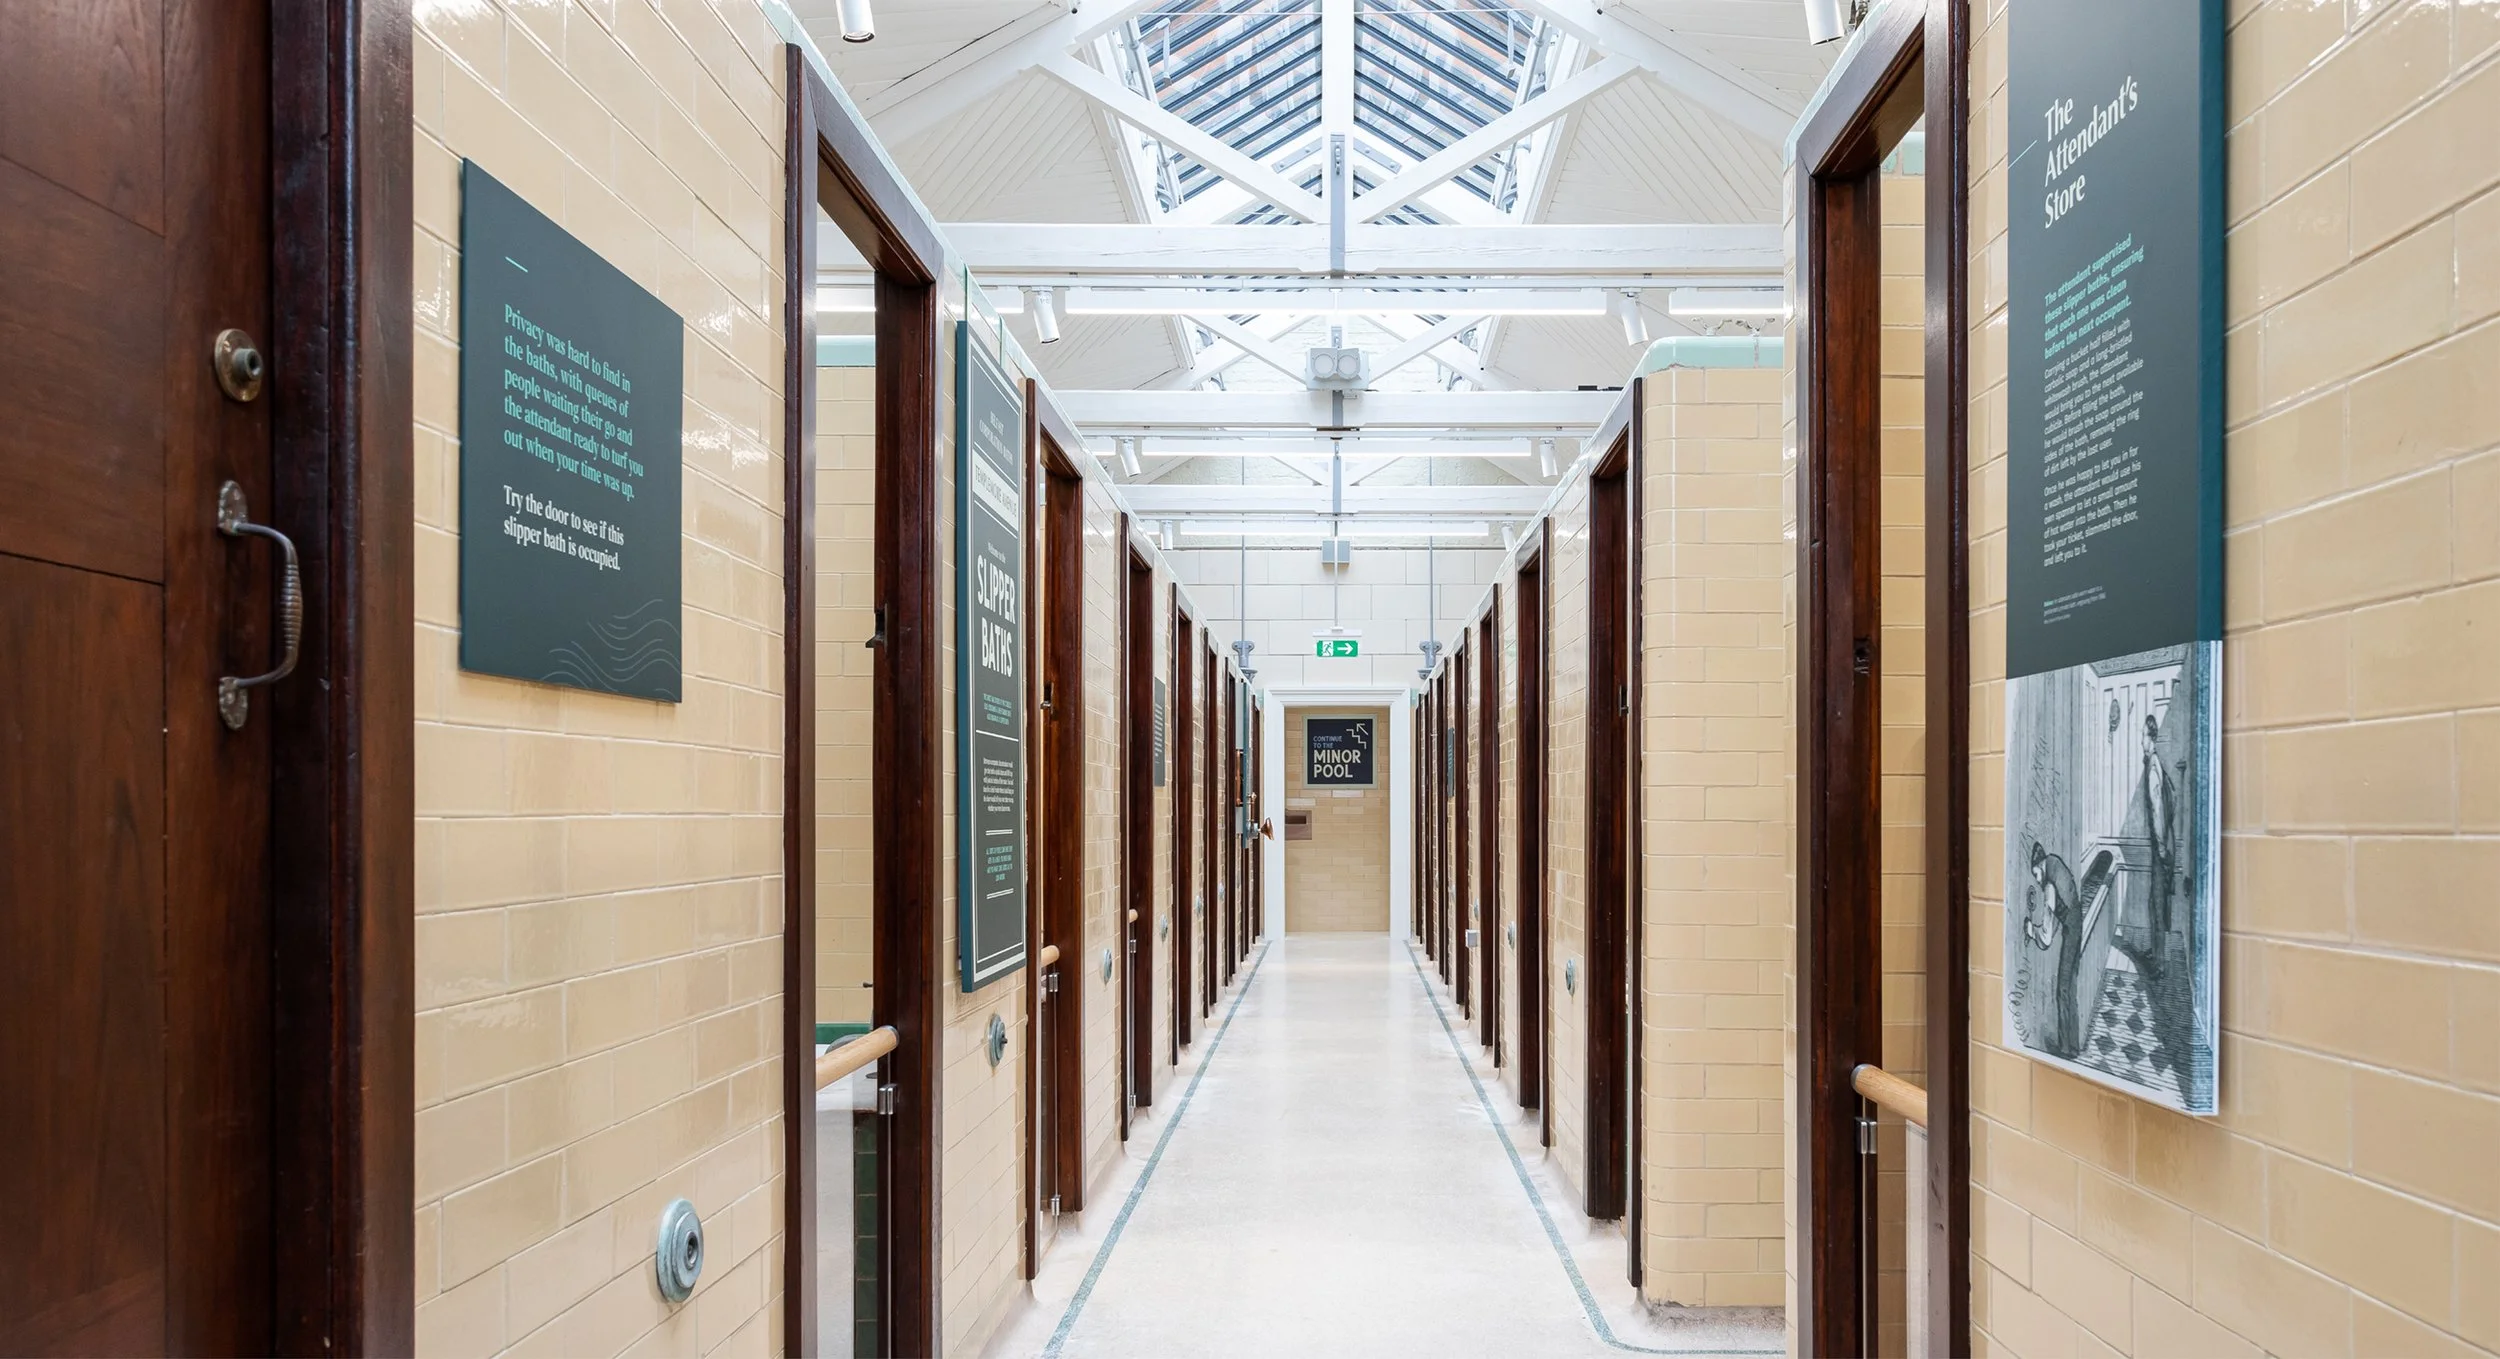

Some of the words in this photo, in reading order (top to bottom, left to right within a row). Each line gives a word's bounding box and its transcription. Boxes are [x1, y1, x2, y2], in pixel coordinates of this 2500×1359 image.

[2044, 96, 2074, 142] The
[2045, 75, 2138, 188] Attendant's
[2045, 174, 2086, 229] Store
[2045, 292, 2057, 306] The
[2058, 265, 2091, 296] attendant
[2092, 235, 2131, 272] supervised
[2045, 305, 2062, 324] these
[2063, 288, 2086, 310] slipper
[2087, 274, 2110, 294] baths,
[2111, 248, 2144, 277] ensuring
[2045, 323, 2058, 341] that
[2059, 311, 2076, 331] each
[2076, 305, 2089, 320] one
[2090, 294, 2105, 310] was
[2106, 280, 2127, 300] clean
[2045, 339, 2065, 358] before
[2066, 331, 2077, 345] the
[2078, 318, 2094, 336] next
[2095, 296, 2131, 326] occupant.
[505, 305, 544, 347] Privacy
[547, 334, 565, 355] was
[568, 342, 590, 369] hard
[592, 357, 601, 375] to
[603, 362, 620, 386] find
[622, 373, 630, 392] in
[505, 335, 523, 360] the
[526, 346, 558, 381] baths,
[560, 369, 582, 392] with
[585, 384, 617, 411] queues
[620, 400, 629, 418] of
[505, 369, 540, 400] people
[543, 389, 579, 424] waiting
[581, 405, 603, 431] their
[605, 421, 615, 440] go
[617, 427, 632, 445] and
[505, 395, 522, 419] the
[525, 408, 571, 442] attendant
[574, 433, 599, 459] ready
[601, 443, 610, 460] to
[612, 448, 628, 469] turf
[629, 459, 643, 476] you
[504, 429, 523, 449] out
[526, 437, 554, 462] when
[556, 452, 579, 473] your
[581, 459, 601, 483] time
[603, 473, 619, 491] was
[621, 481, 634, 502] up.
[504, 485, 523, 513] Try
[526, 495, 543, 516] the
[545, 501, 569, 525] door
[571, 511, 581, 529] to
[582, 519, 598, 535] see
[600, 521, 607, 539] if
[608, 525, 624, 545] this
[504, 517, 541, 546] slipper
[544, 528, 566, 552] bath
[568, 536, 576, 555] is
[578, 545, 620, 570] occupied.
[977, 554, 1016, 624] SLIPPER
[981, 617, 1012, 678] BATHS
[1314, 749, 1361, 763] MINOR
[1314, 764, 1353, 778] POOL
